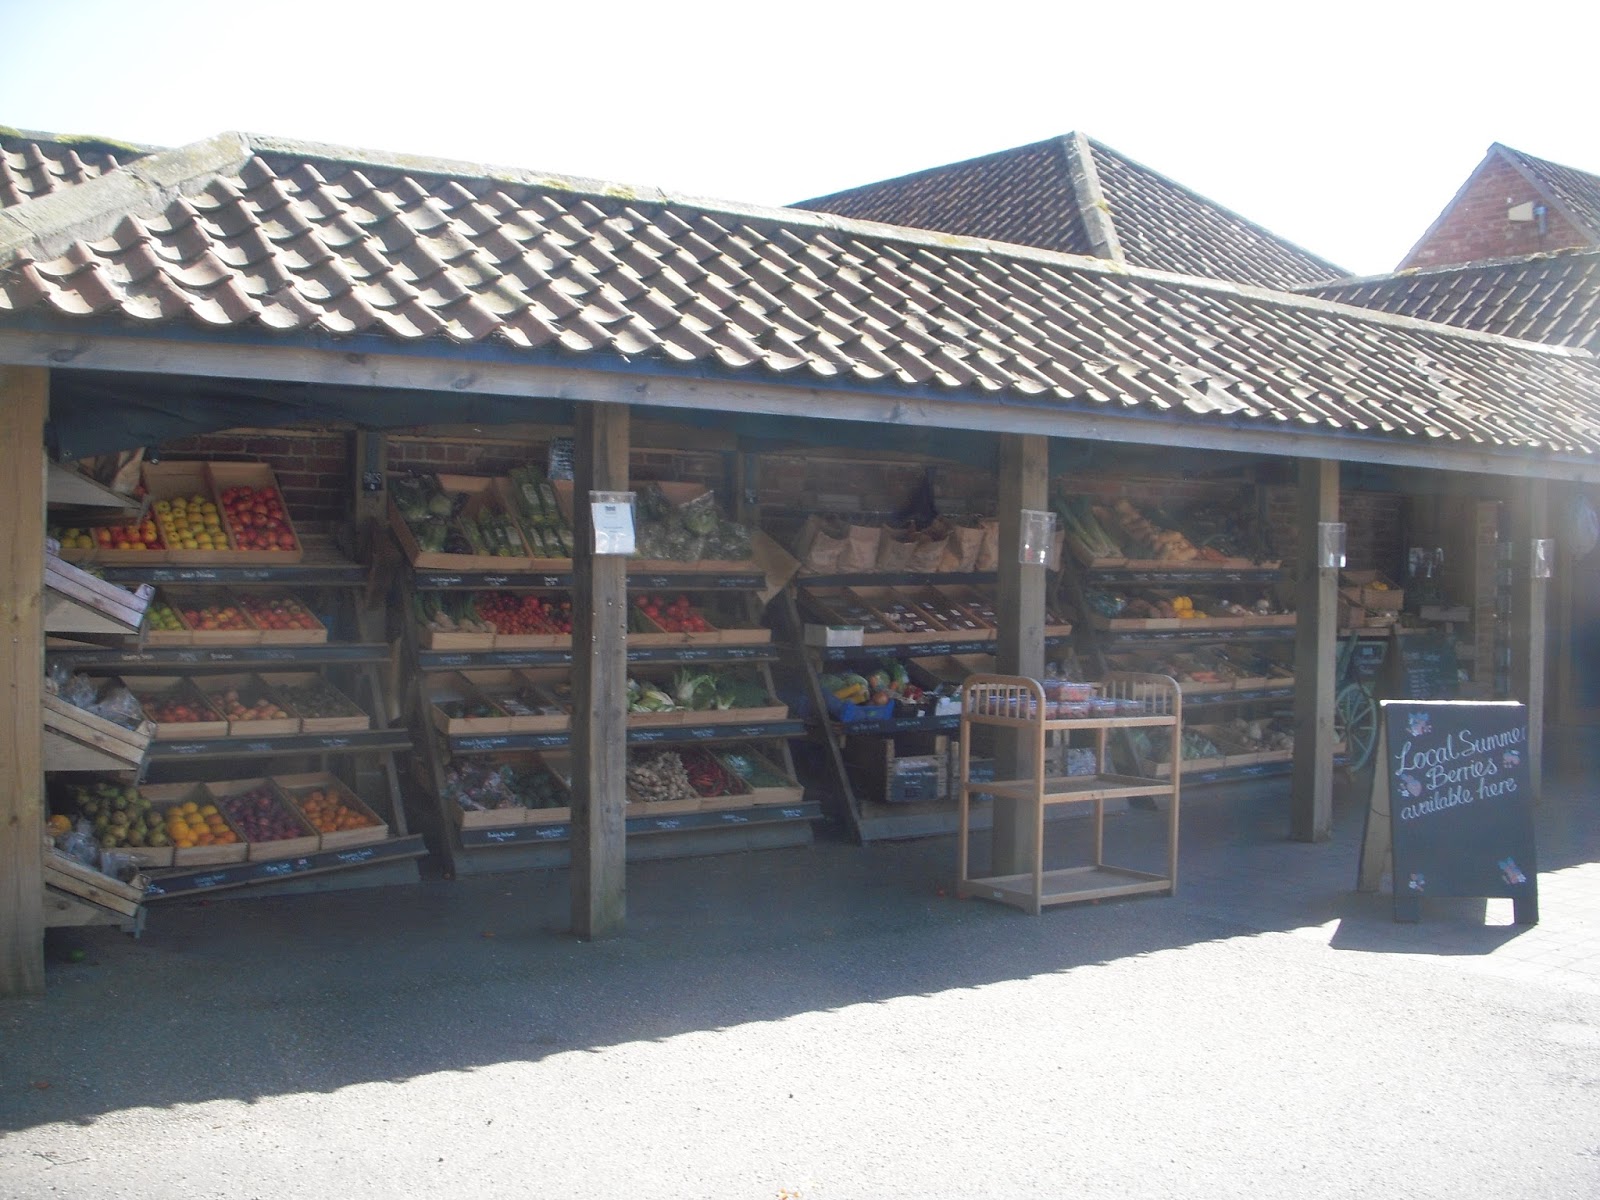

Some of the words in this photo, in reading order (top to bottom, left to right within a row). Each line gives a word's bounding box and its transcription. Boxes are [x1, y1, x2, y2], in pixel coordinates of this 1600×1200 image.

[1395, 734, 1460, 776] Local
[1458, 726, 1527, 757] Summer
[1426, 757, 1498, 790] Berries
[1400, 783, 1474, 820] available
[1475, 777, 1518, 800] here
